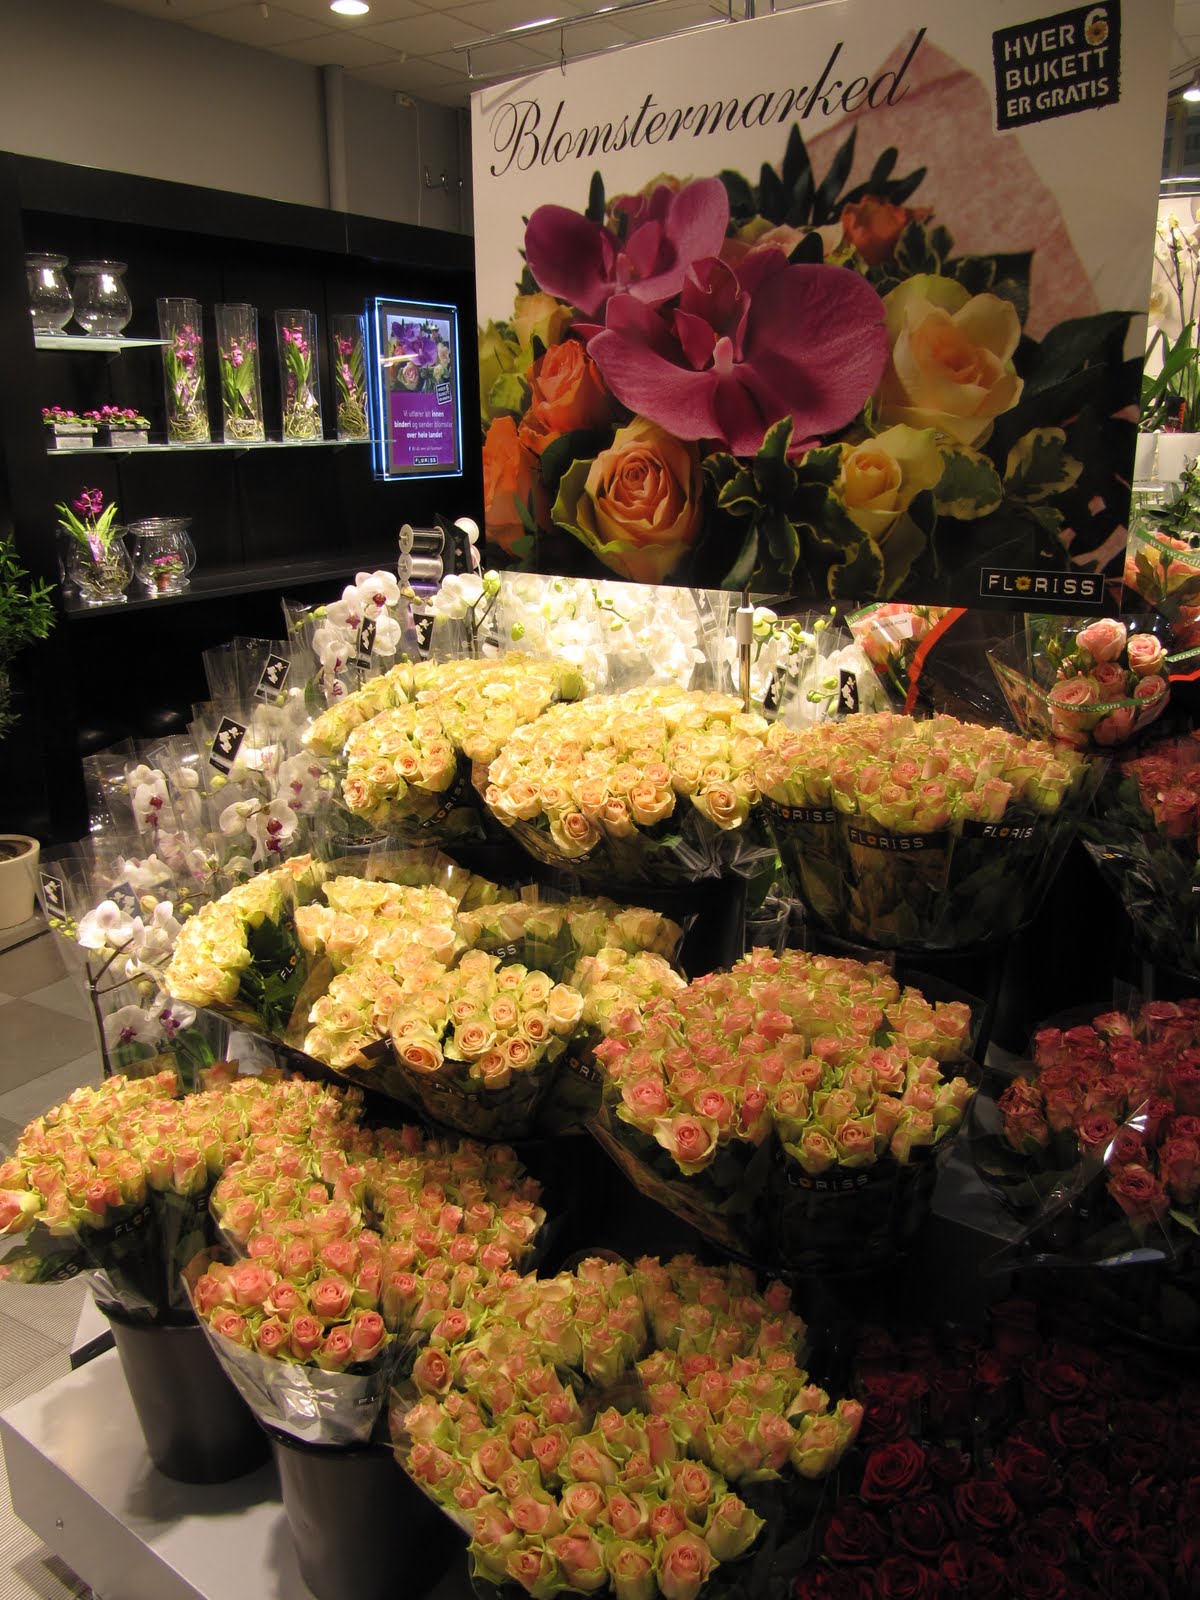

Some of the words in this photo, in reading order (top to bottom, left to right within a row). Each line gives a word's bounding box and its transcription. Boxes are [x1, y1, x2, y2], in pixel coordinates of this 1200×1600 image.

[1004, 24, 1075, 61] HVER
[1084, 7, 1109, 46] 6
[1005, 46, 1109, 91] BUKETT
[490, 27, 927, 177] Blomstermarked
[1006, 96, 1031, 117] ER
[1035, 77, 1110, 110] GRATIS
[988, 574, 1095, 596] FLORISS
[423, 778, 466, 829] FLORISS
[851, 830, 924, 849] FLORISS
[983, 826, 1034, 839] FLORIS
[786, 1173, 869, 1191] LORISS
